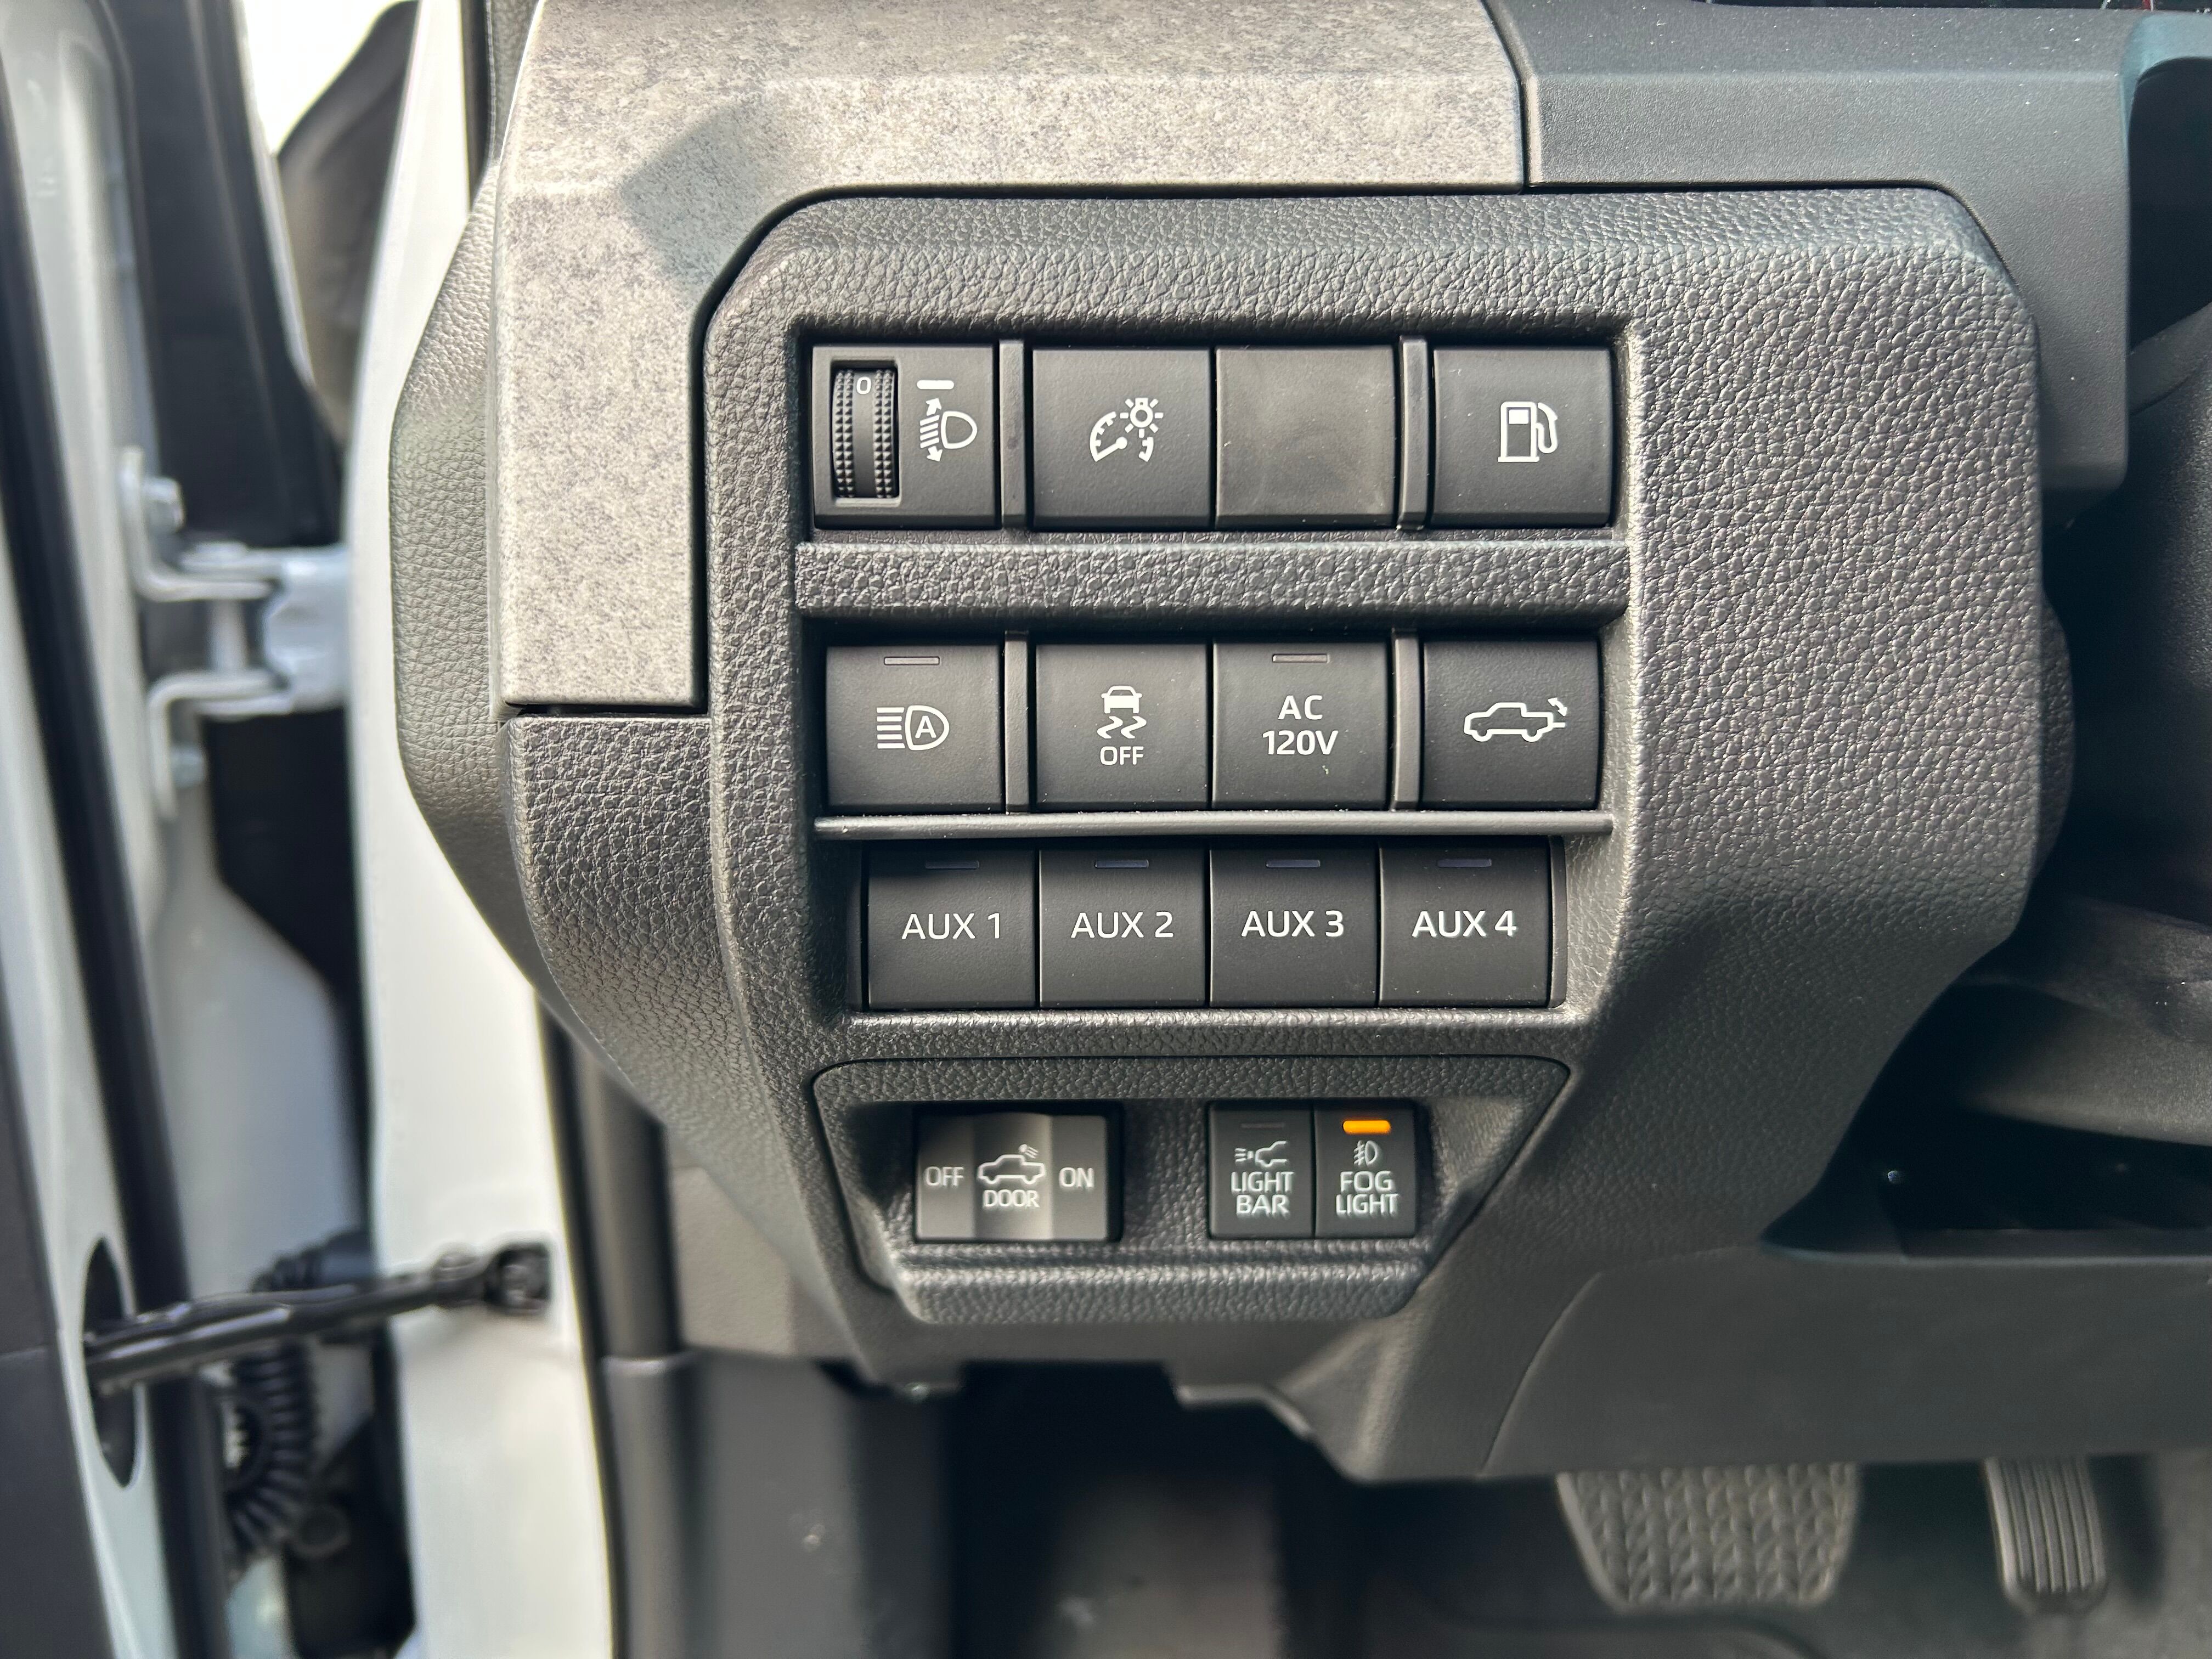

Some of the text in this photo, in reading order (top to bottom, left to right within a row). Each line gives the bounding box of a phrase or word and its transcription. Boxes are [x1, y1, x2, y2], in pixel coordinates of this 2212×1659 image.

[856, 376, 872, 394] 0
[1278, 695, 1323, 720] AC
[915, 715, 937, 738] A
[1262, 730, 1339, 755] 120V
[1100, 746, 1144, 765] OFF
[901, 912, 1000, 940] AUX 1
[1070, 911, 1173, 938] AUX 2
[1241, 910, 1344, 938] AUX 3
[1412, 910, 1517, 938] AUX 4
[925, 1166, 964, 1187] OFF
[1059, 1167, 1094, 1189] ON
[1231, 1171, 1294, 1193] LIGHT
[1340, 1171, 1393, 1192] FOG
[984, 1189, 1041, 1209] DOOR
[1236, 1194, 1289, 1215] BAR
[1336, 1193, 1398, 1215] LIGHT
